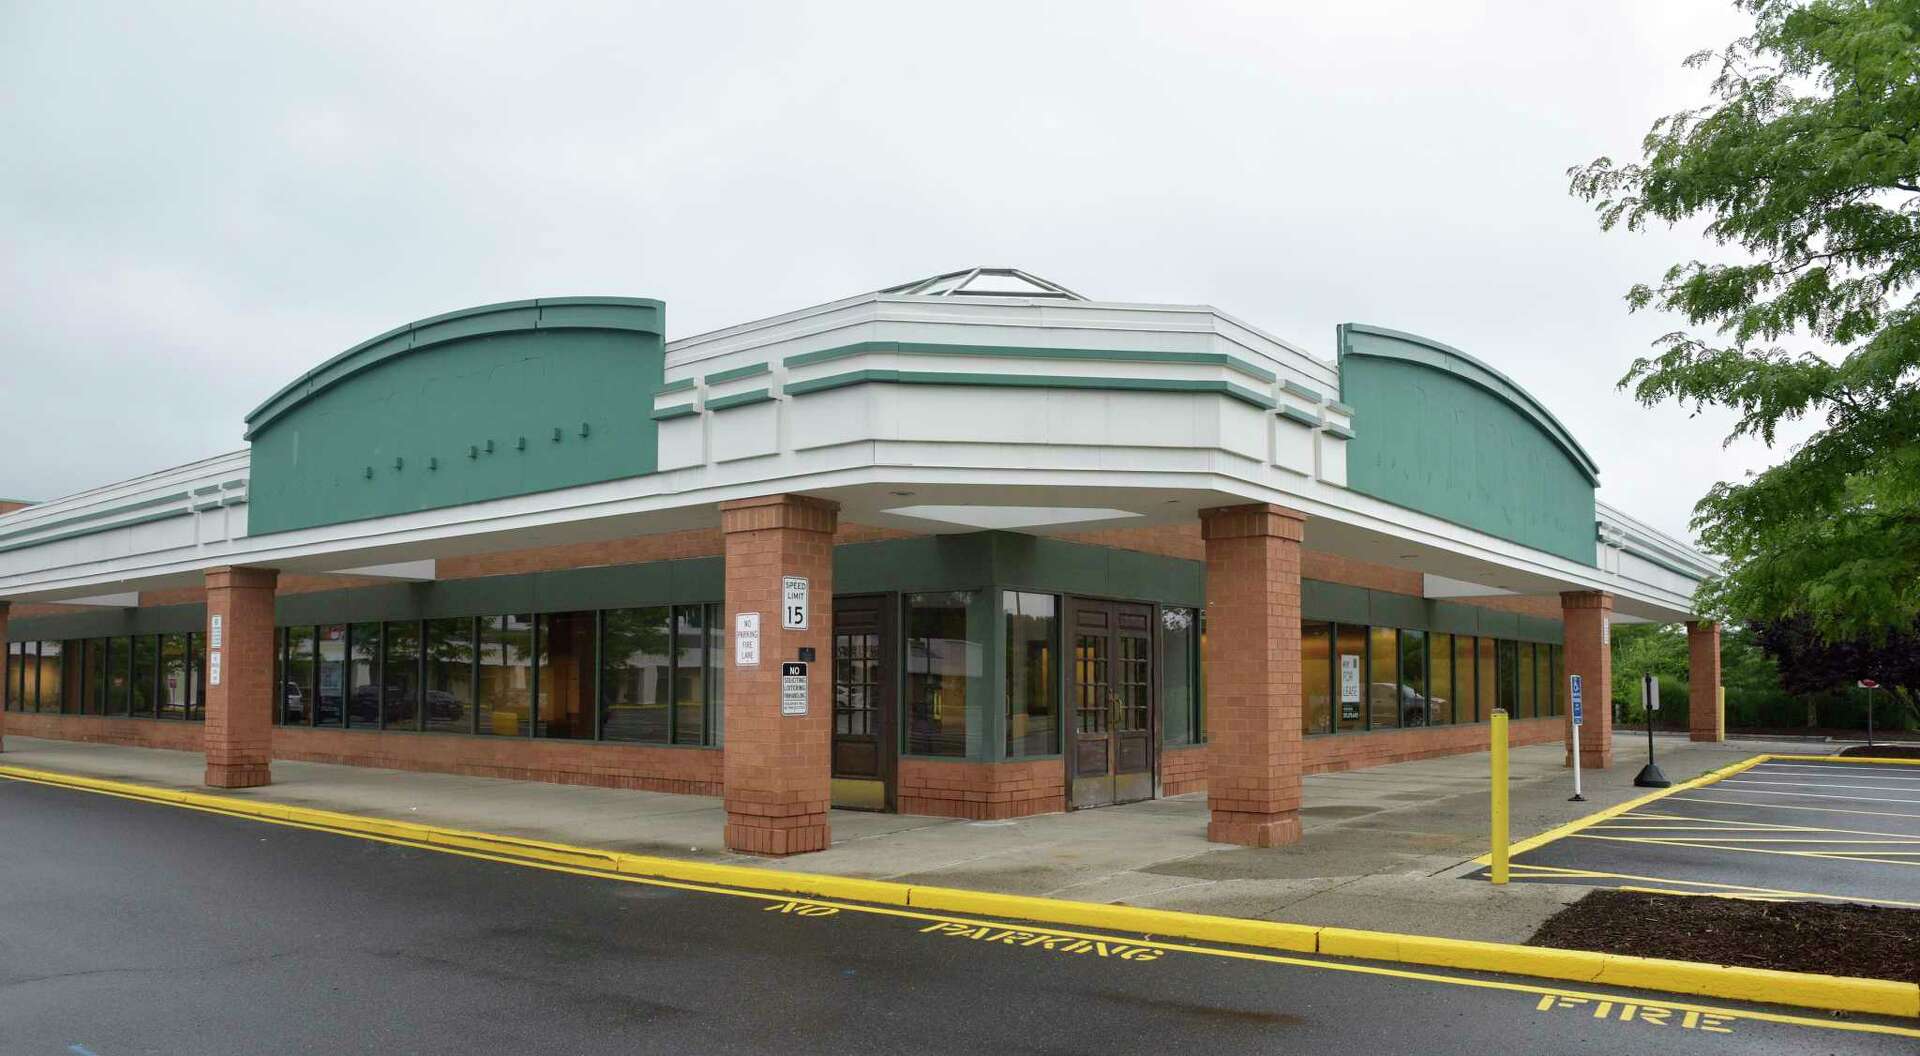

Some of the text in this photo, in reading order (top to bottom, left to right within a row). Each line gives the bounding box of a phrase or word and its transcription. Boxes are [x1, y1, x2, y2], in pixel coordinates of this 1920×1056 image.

[786, 581, 806, 590] SPEED
[788, 592, 804, 600] LIMIT
[788, 606, 803, 624] 15
[744, 619, 752, 628] NO
[737, 631, 758, 639] PARKING
[742, 641, 753, 649] FIRE
[741, 652, 753, 660] LANE
[789, 666, 800, 675] NO
[765, 901, 1165, 961] NO PARKING
[1535, 994, 1737, 1034] FIRE
